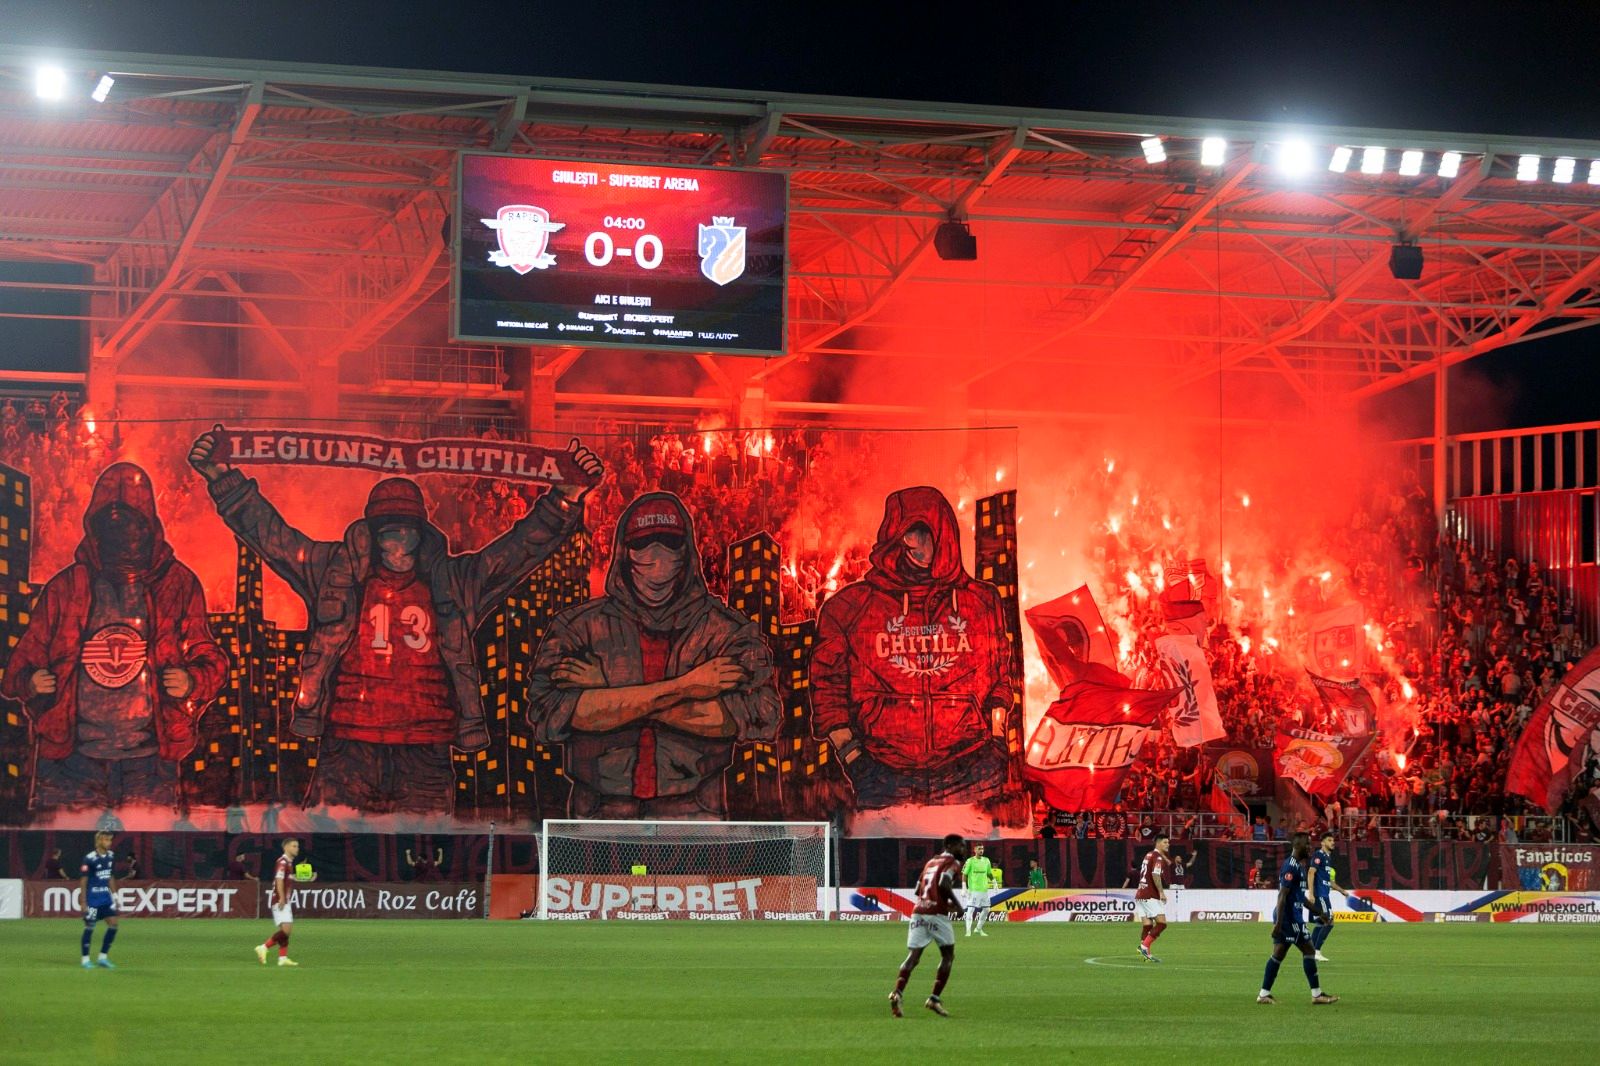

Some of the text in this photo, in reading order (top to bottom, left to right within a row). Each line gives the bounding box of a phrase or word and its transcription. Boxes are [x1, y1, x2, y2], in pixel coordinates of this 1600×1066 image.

[552, 170, 598, 187] GIULEȘTI
[609, 173, 661, 189] SUPERBET
[663, 177, 699, 191] ARENA
[603, 215, 645, 230] 04:00
[584, 232, 664, 270] 0-0
[230, 436, 564, 480] LEGIUNEA CHITILA
[636, 513, 677, 528] ULTRAS
[370, 603, 432, 655] 13
[876, 632, 973, 658] CHITILA
[1515, 848, 1592, 867] Fanaticos
[265, 888, 477, 912] TATTORIA Roz Café
[547, 877, 763, 912] SUPERBET
[1006, 898, 1136, 914] www.mobexpert.ro
[617, 911, 669, 920] SUPERBET
[689, 911, 742, 920] SUPERBET
[764, 911, 817, 920] SUPERBET
[839, 912, 892, 922] SUPERBET
[1074, 914, 1130, 922] MOBEXPERT
[1206, 912, 1252, 920] IMAMED
[1334, 913, 1372, 921] INANCE
[1539, 913, 1556, 922] VRK
